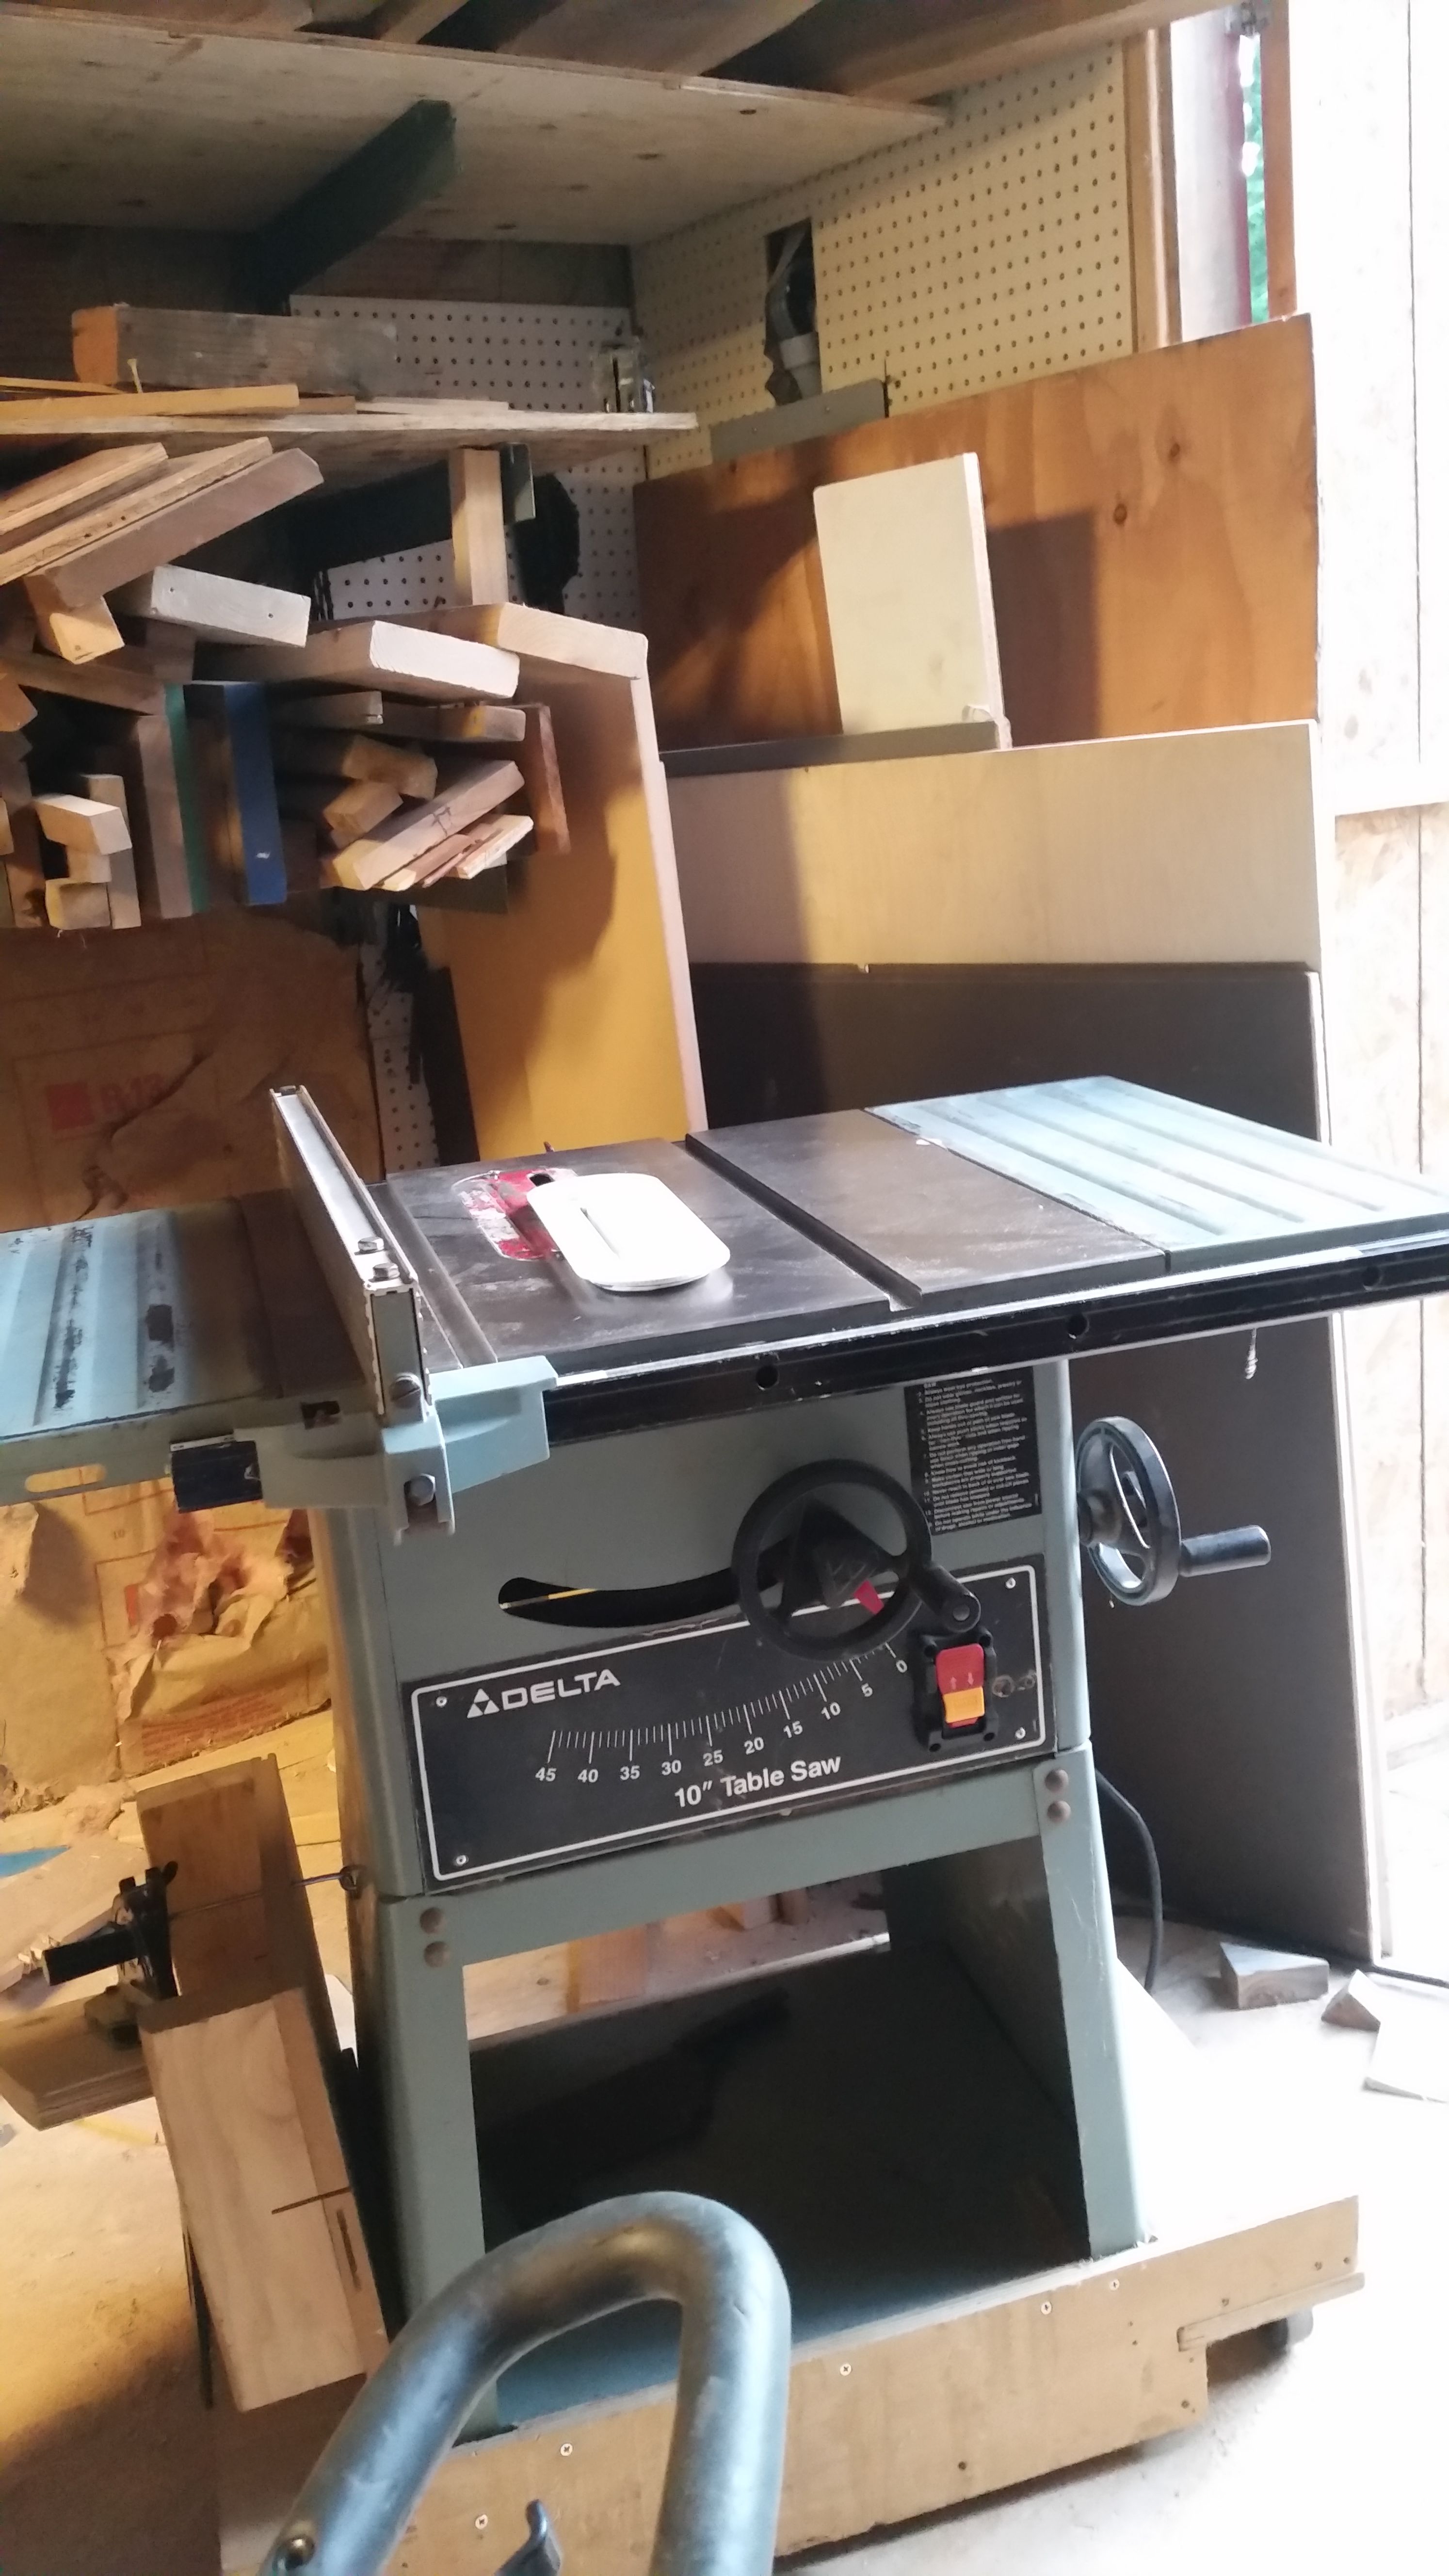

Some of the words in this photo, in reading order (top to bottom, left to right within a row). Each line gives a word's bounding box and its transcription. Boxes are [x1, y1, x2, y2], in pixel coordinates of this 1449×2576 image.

[501, 1669, 621, 1710] DELTA
[535, 1767, 557, 1782] 45
[577, 1769, 598, 1783] 40
[620, 1765, 640, 1780] 35
[661, 1759, 682, 1776] 30
[703, 1749, 723, 1767] 25
[744, 1737, 764, 1755] 20
[783, 1721, 803, 1738] 15
[821, 1702, 841, 1720] 10
[861, 1683, 873, 1697] 5
[896, 1660, 907, 1673] 0
[720, 1767, 785, 1797] Table
[790, 1756, 841, 1782] Saw
